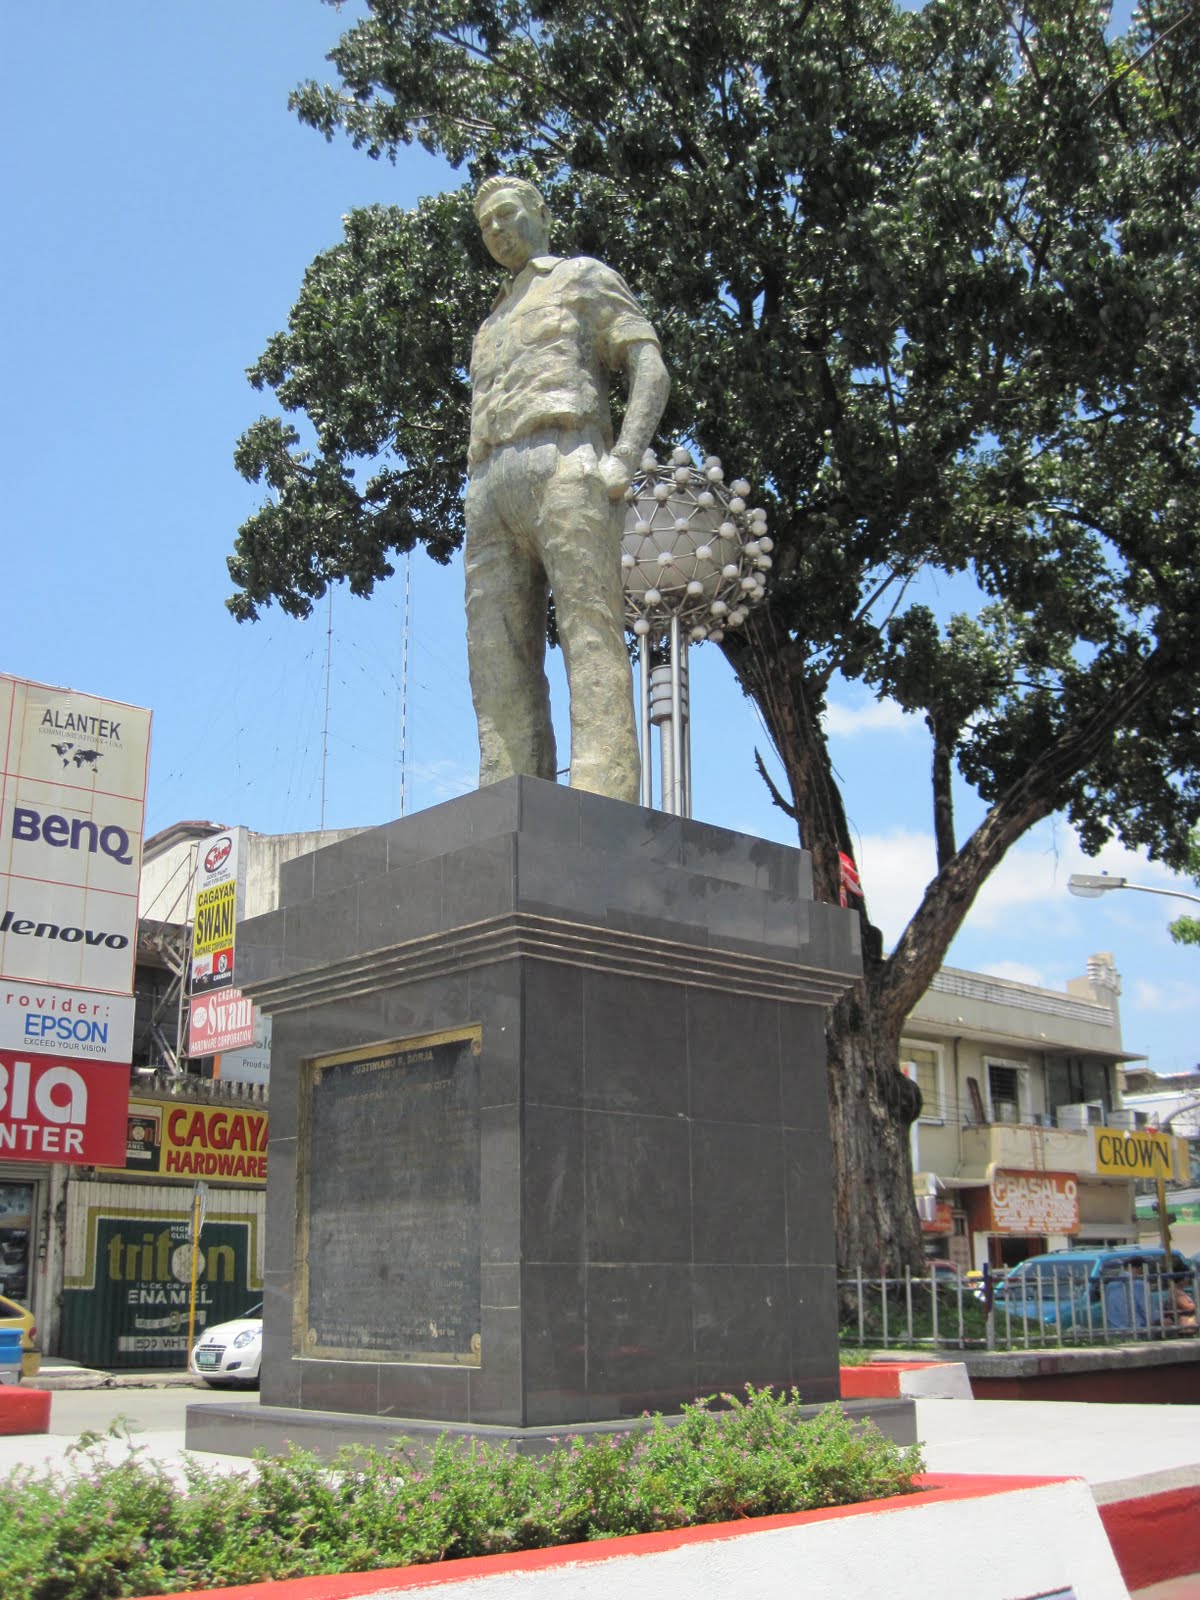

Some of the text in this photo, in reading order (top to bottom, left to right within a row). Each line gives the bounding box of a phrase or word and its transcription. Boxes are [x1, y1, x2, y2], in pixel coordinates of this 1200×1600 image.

[41, 708, 121, 741] ALANTEK
[12, 807, 133, 866] BenQ
[198, 882, 235, 908] CAGAYAN
[0, 910, 129, 950] lenovo
[196, 899, 233, 946] SWANI
[25, 1013, 108, 1044] EPSON
[190, 1030, 252, 1053] HARDWARE CORPORATION
[24, 1037, 107, 1054] EXCEED YOUR VISION
[243, 1059, 262, 1069] Proud
[166, 1150, 267, 1178] HARDWARE
[1098, 1135, 1170, 1169] CROWN
[1007, 1176, 1077, 1200] BASALO
[128, 1289, 213, 1304] ENAMEL
[162, 1338, 198, 1348] WHTE
